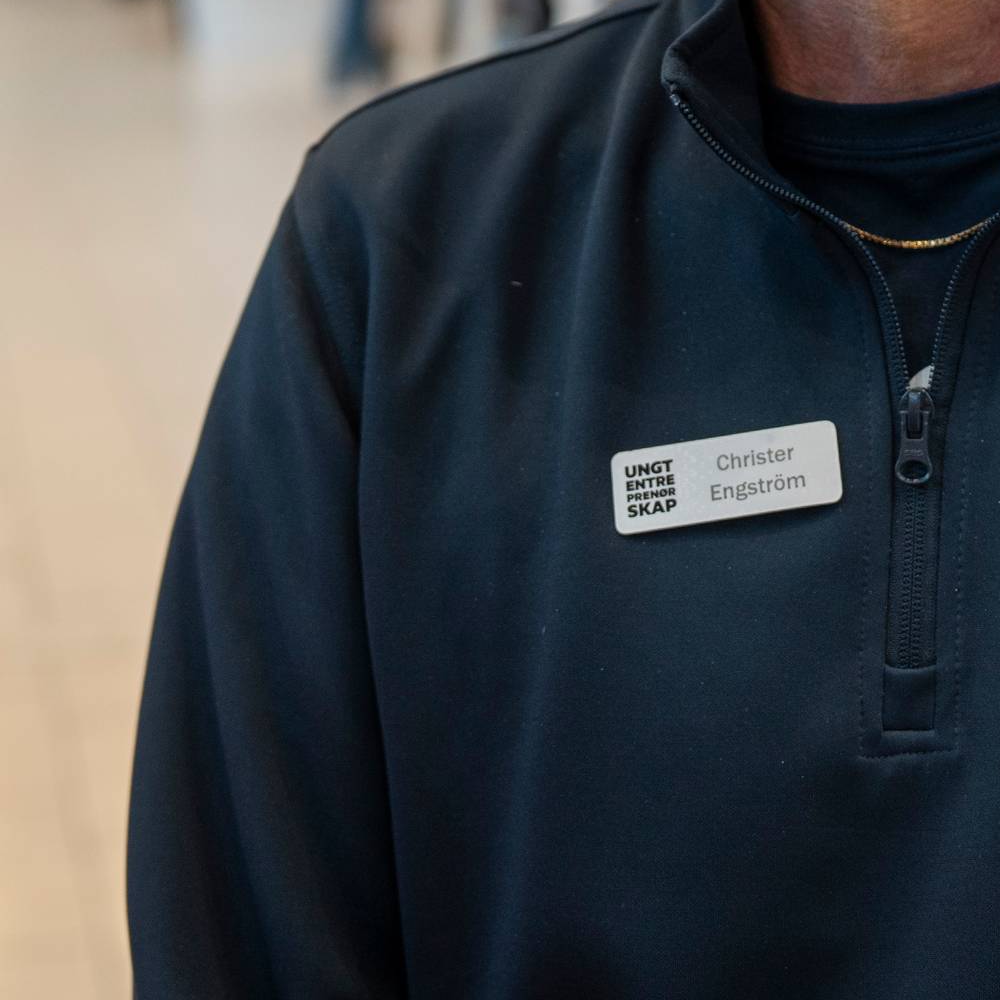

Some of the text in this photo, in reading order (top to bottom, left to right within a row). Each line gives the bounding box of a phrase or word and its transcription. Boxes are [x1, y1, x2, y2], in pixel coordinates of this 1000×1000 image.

[624, 459, 674, 478] UNGT
[716, 447, 795, 472] Christer
[625, 474, 676, 492] ENTRE
[710, 473, 807, 501] Engström
[626, 487, 677, 503] PRENØR
[627, 498, 678, 518] SKAP
